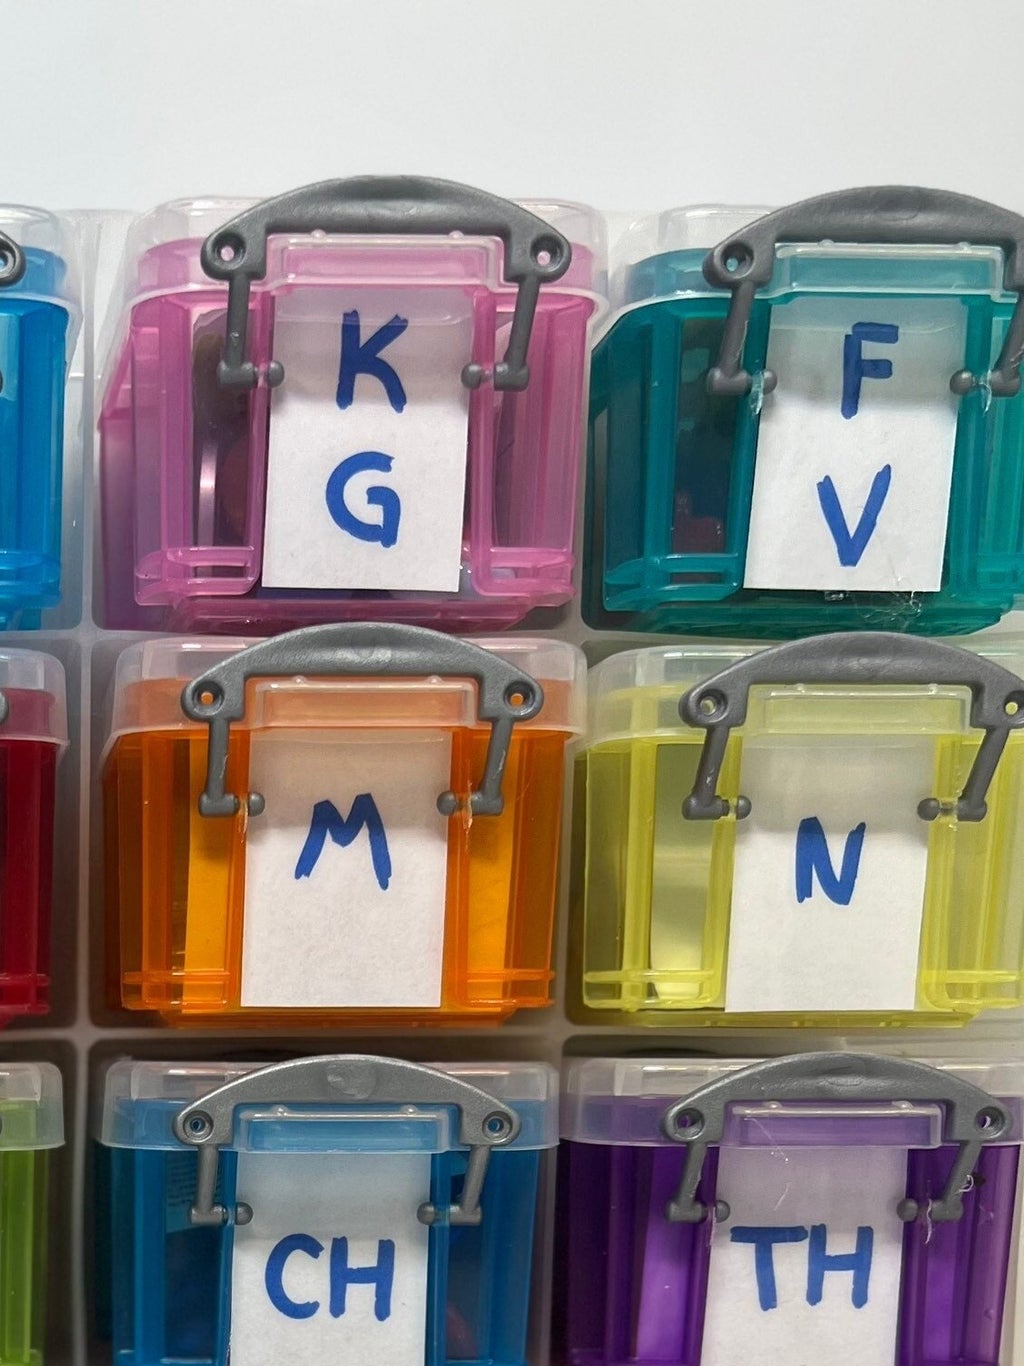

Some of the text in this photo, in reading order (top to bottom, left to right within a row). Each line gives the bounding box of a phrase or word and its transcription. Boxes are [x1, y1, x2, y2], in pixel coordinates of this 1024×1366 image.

[335, 309, 407, 413] K
[840, 321, 900, 419] F
[325, 451, 401, 549] G
[816, 464, 892, 568] V
[294, 793, 391, 890] M
[795, 817, 865, 906] N
[264, 1233, 395, 1322] CH
[729, 1225, 874, 1313] TH
